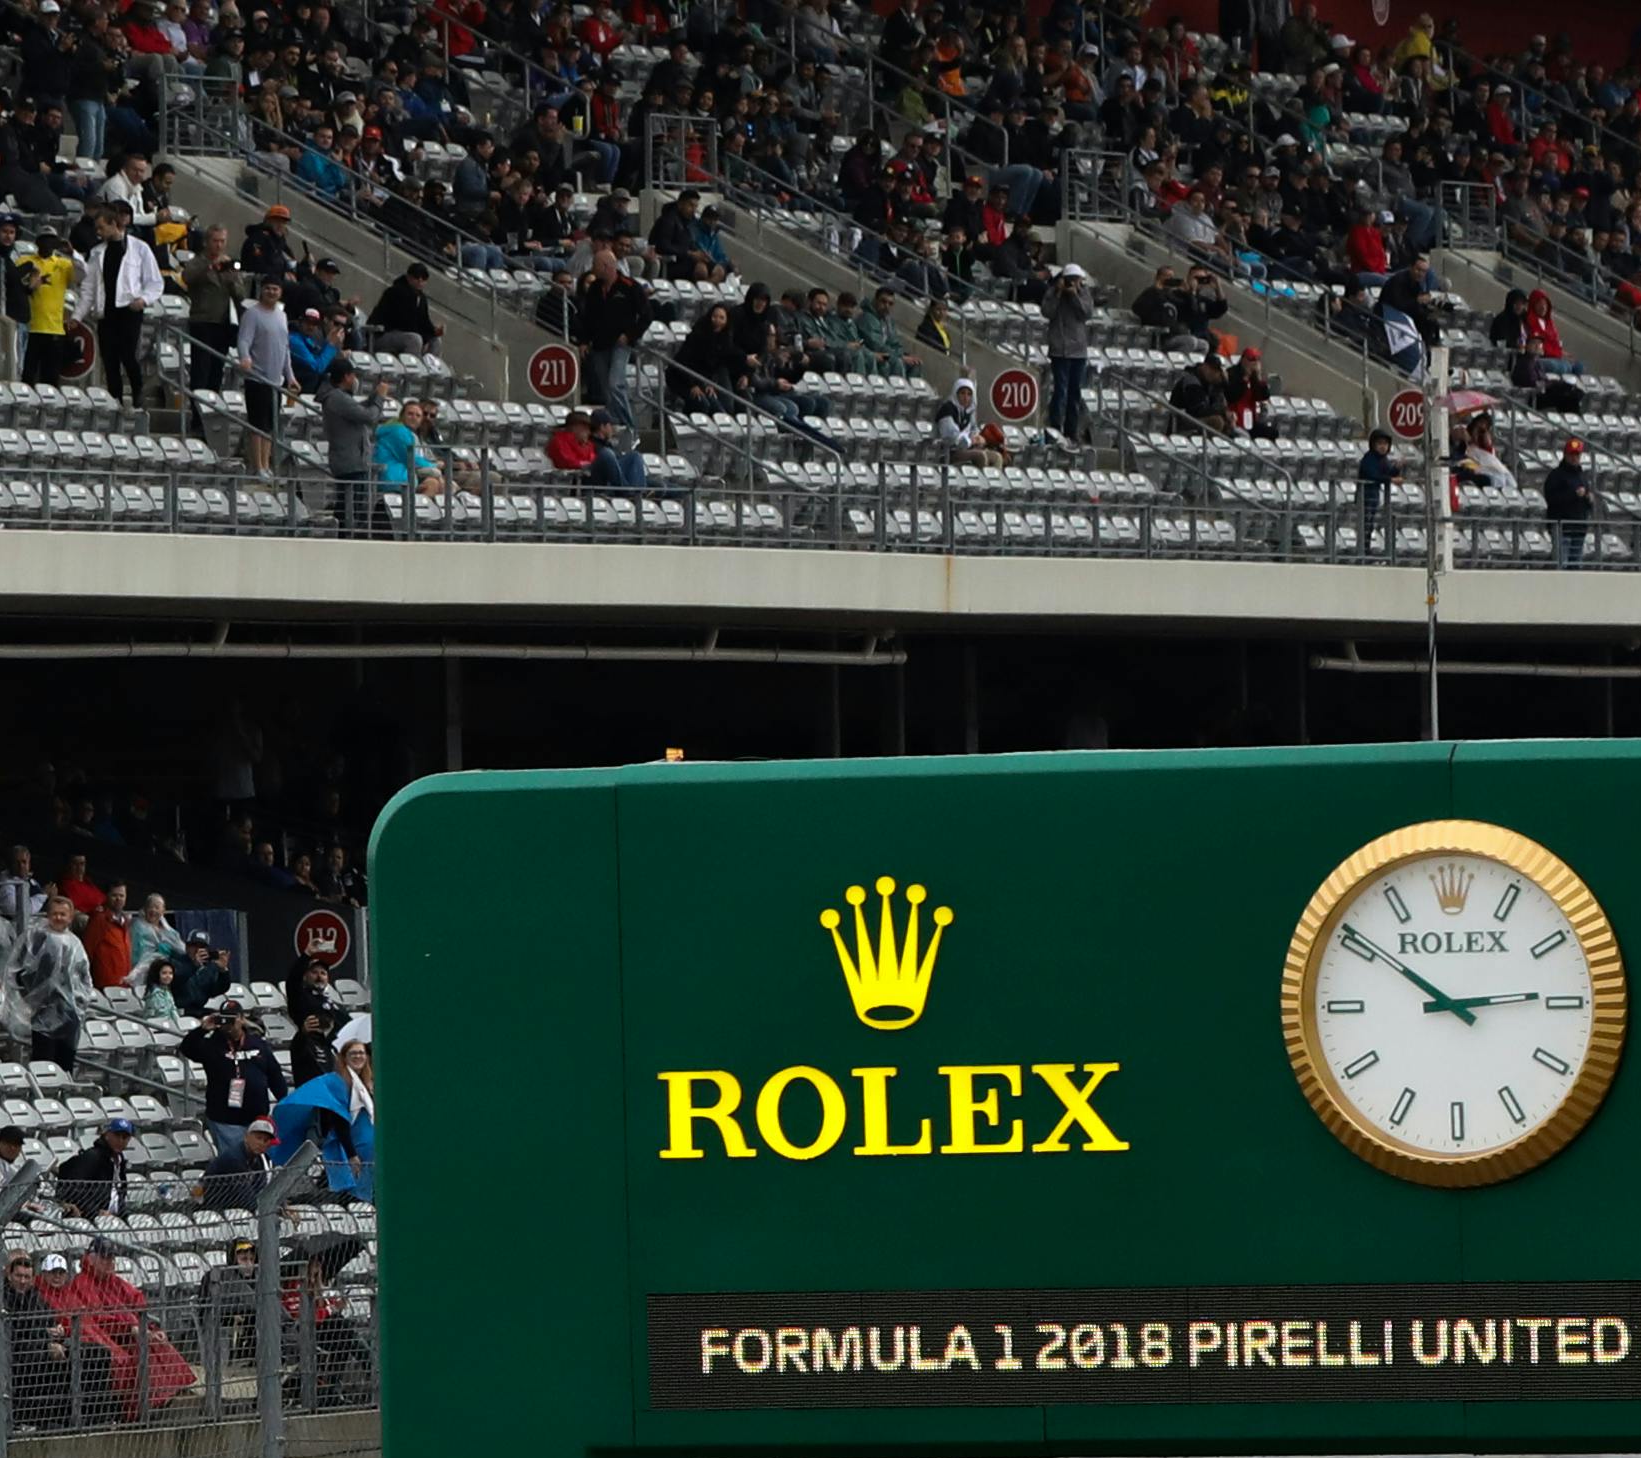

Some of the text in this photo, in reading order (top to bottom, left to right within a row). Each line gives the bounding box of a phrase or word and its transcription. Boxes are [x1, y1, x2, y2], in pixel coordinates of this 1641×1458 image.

[539, 360, 567, 386] 211
[1001, 378, 1031, 408] 210
[1396, 403, 1425, 428] 209
[1397, 930, 1510, 955] ROLEX
[658, 1063, 1130, 1160] ROLEX
[701, 1326, 981, 1374] FORMULA
[995, 1325, 1022, 1370] 1
[1036, 1324, 1173, 1370] 2018
[1189, 1320, 1394, 1368] PIRELLI
[1410, 1317, 1630, 1365] UNITED
